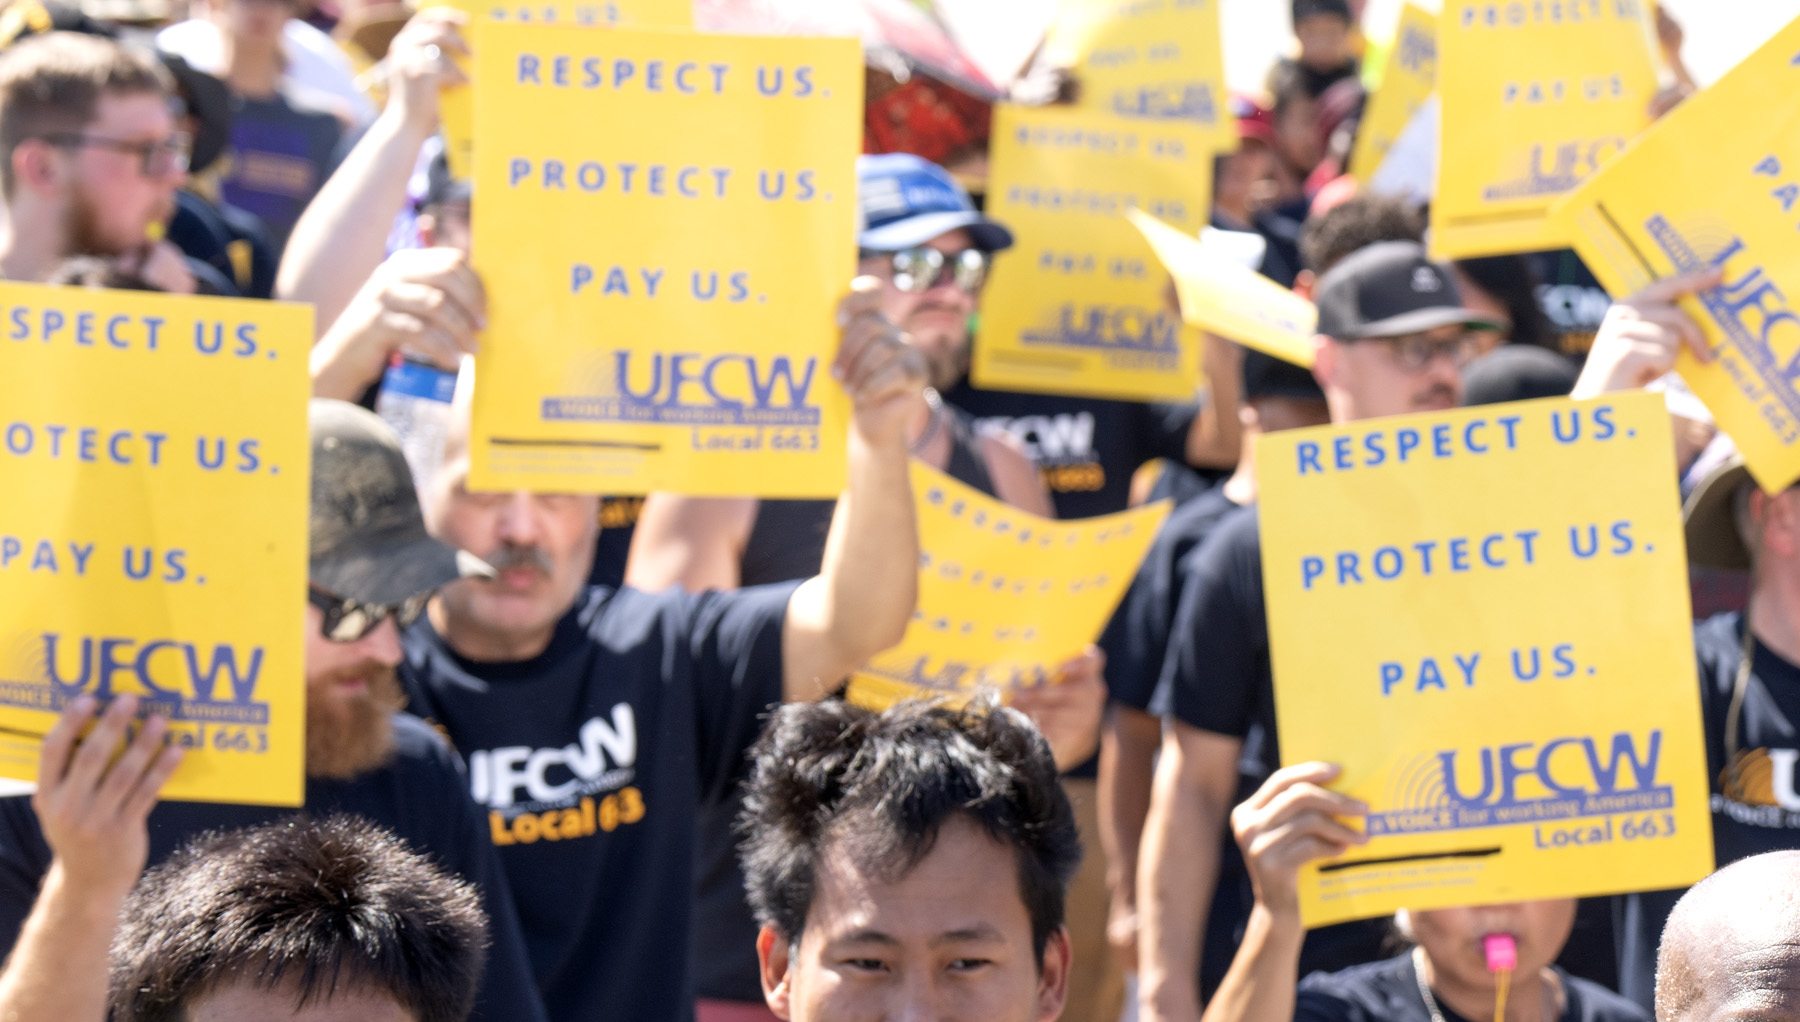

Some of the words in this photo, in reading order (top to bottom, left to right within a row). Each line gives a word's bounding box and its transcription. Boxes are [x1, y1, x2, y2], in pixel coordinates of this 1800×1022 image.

[517, 53, 731, 94] RESPECT
[757, 66, 833, 97] US.
[508, 157, 733, 199] PROTECT
[760, 170, 834, 202] US.
[570, 264, 664, 299] PAY
[691, 271, 768, 303] US.
[0, 306, 166, 350] SPECT
[193, 321, 278, 360] US.
[612, 349, 818, 410] UFCW
[5, 421, 168, 466] OTECT
[196, 436, 280, 475] US.
[692, 428, 763, 452] Local
[1296, 416, 1522, 475] RESPECT
[1551, 406, 1636, 444] US.
[1, 537, 95, 576] PAY
[123, 546, 207, 586] US.
[1301, 530, 1540, 590] PROTECT
[1568, 520, 1655, 559] US.
[41, 632, 265, 703] UFCW
[1379, 652, 1482, 696] PAY
[1511, 644, 1597, 682] US.
[1436, 729, 1663, 808] UFCW
[489, 796, 596, 845] Local
[1534, 815, 1614, 850] Local
[1621, 814, 1678, 841] 663
